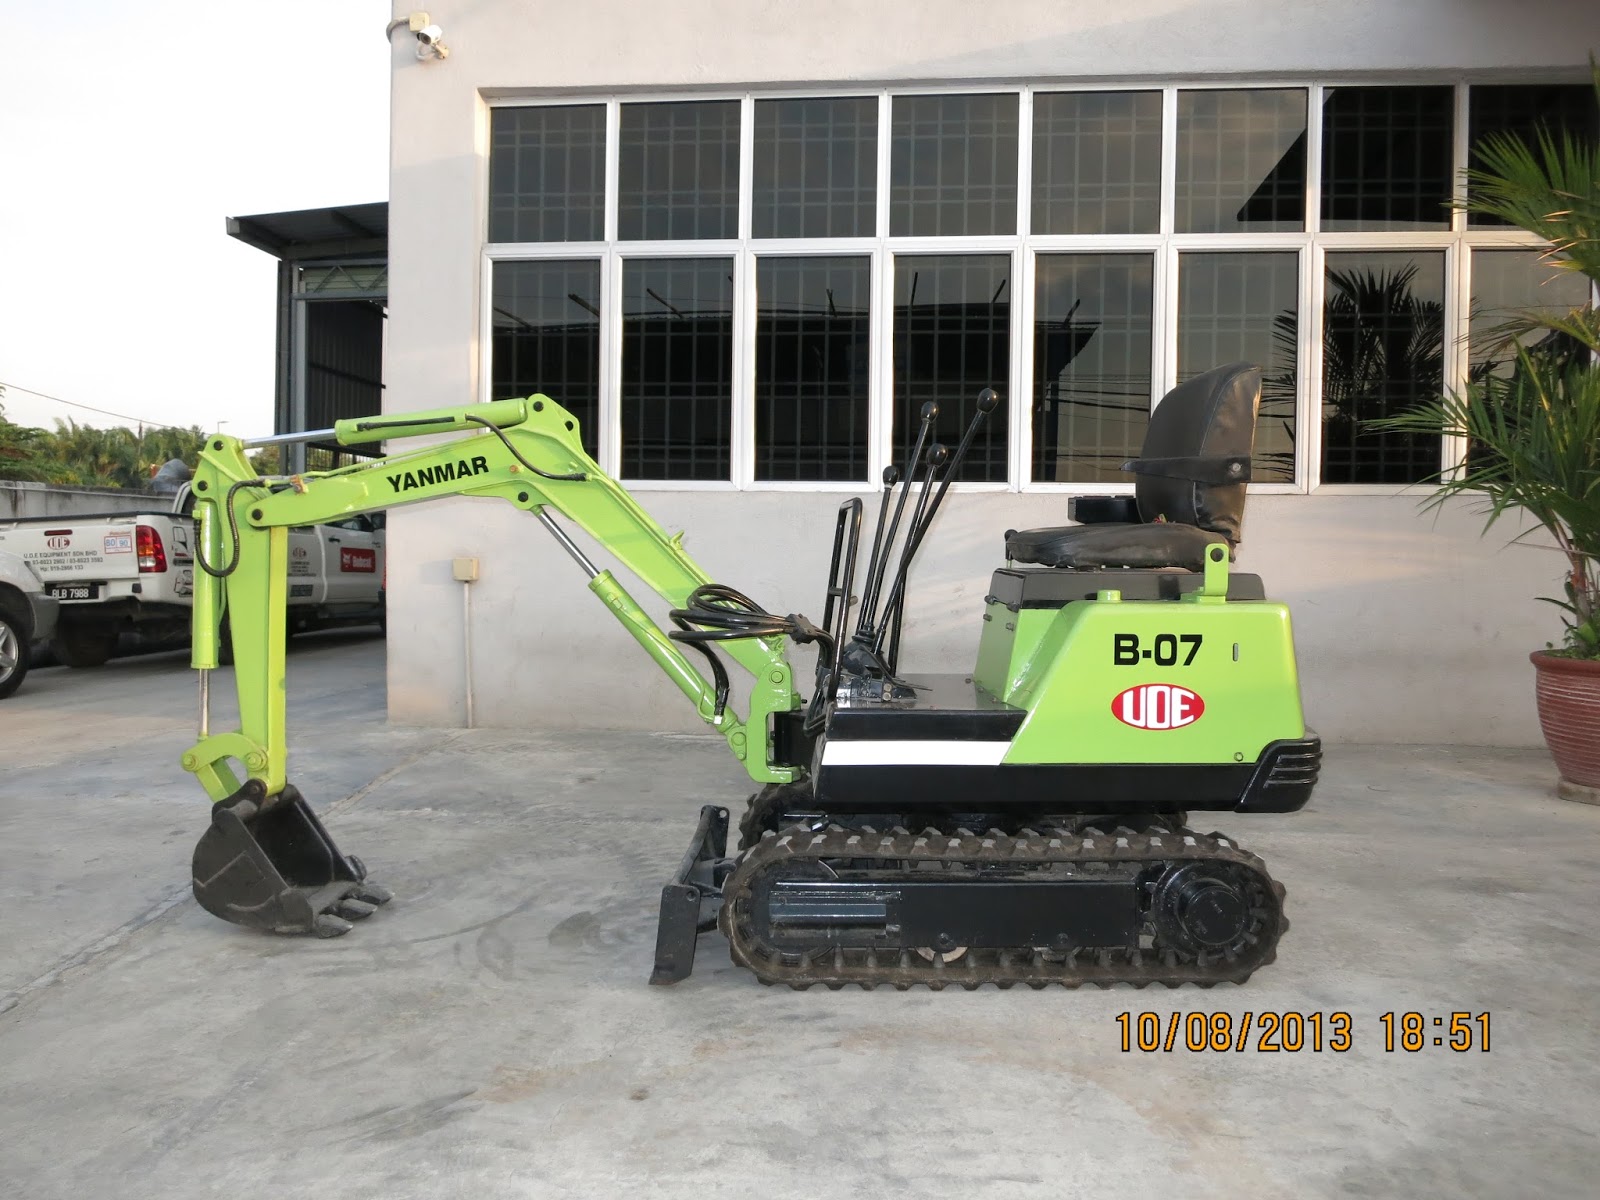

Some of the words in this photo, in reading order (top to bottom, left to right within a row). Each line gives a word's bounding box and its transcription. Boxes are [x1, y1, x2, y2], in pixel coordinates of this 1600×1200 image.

[386, 456, 489, 493] YANMAR
[70, 588, 89, 598] 7988
[1114, 633, 1203, 666] B-07
[1122, 685, 1195, 729] UOE
